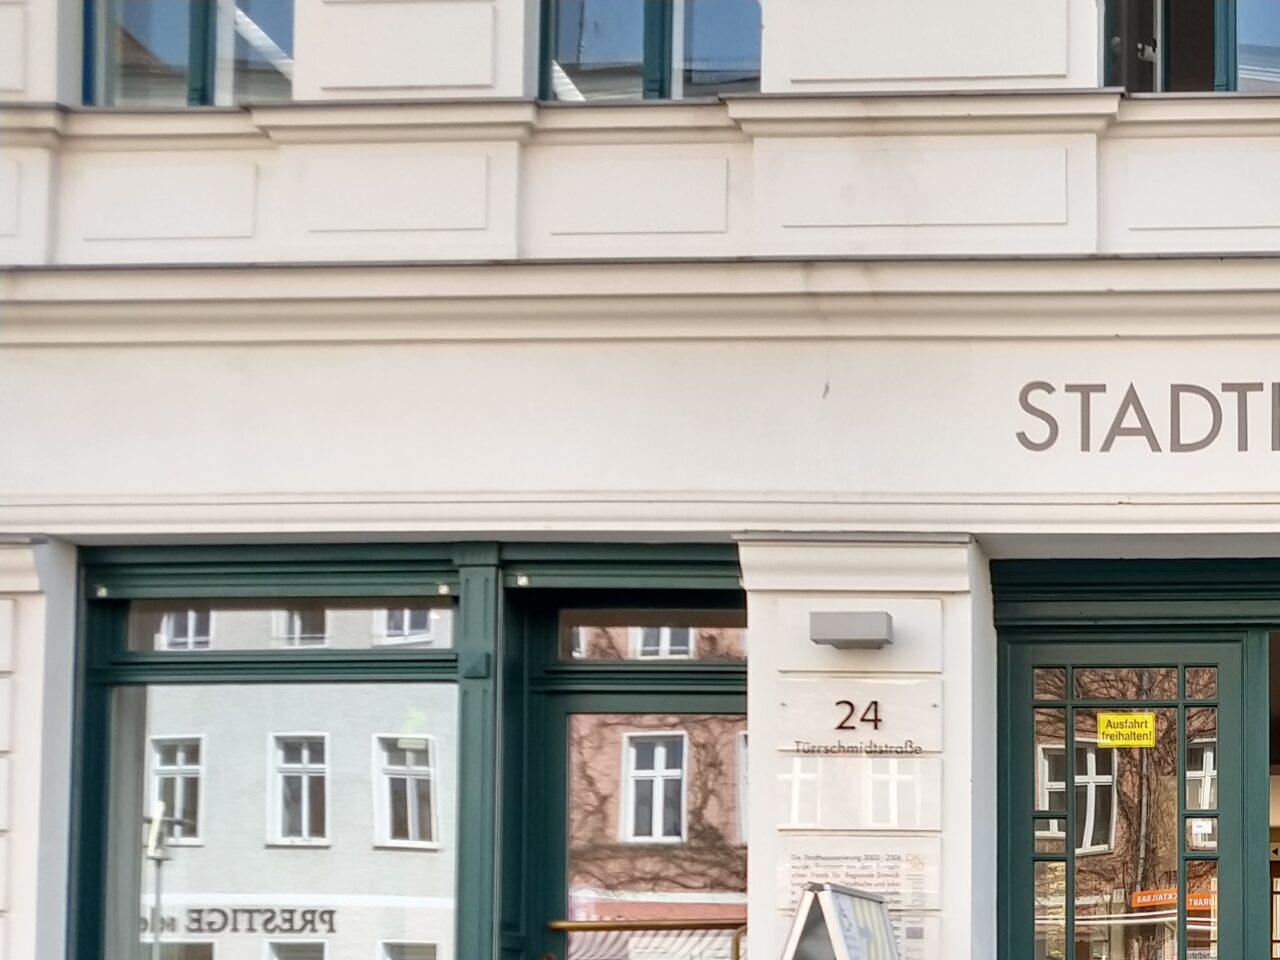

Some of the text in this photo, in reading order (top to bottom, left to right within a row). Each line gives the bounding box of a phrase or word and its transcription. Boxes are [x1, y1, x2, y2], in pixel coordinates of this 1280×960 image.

[834, 700, 883, 731] 24
[1105, 718, 1149, 729] Ausfahrt
[1101, 730, 1152, 741] freihalten!
[793, 739, 924, 755] Türrschmidtstraße
